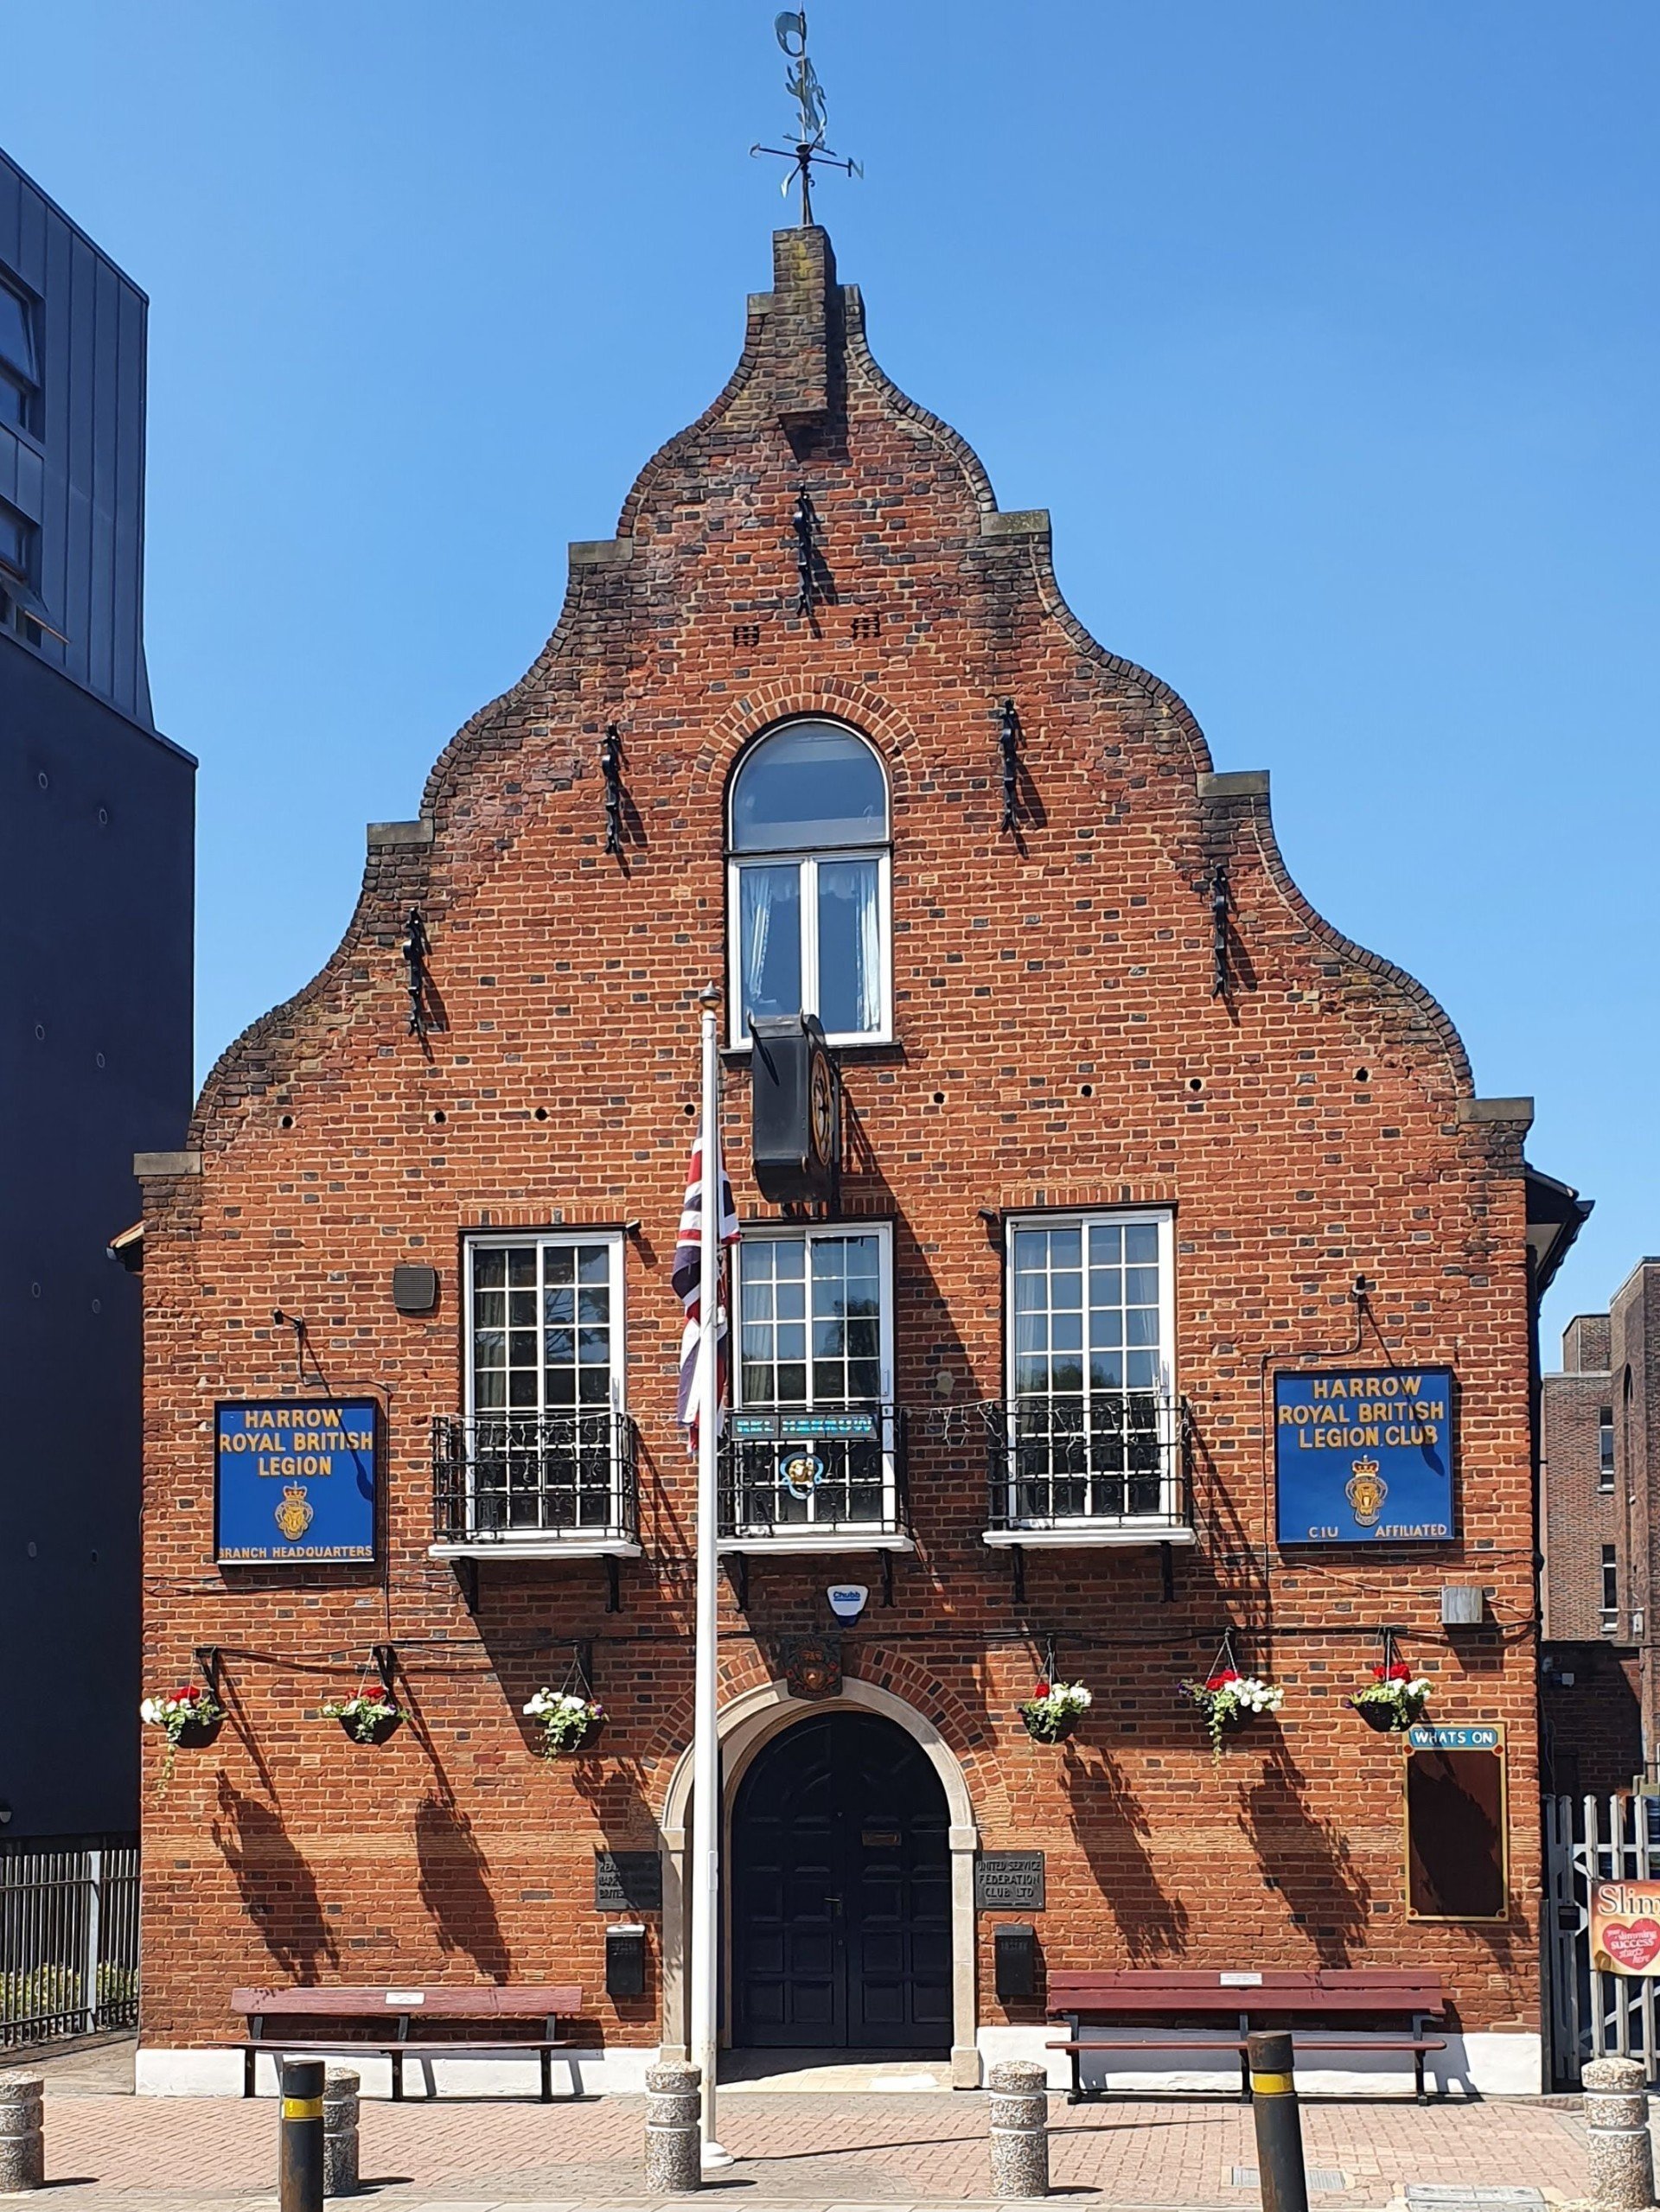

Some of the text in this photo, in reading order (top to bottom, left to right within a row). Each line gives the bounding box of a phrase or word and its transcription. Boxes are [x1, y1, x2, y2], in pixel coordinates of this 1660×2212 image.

[847, 156, 864, 180] N
[1313, 1375, 1421, 1399] HARROW
[245, 1408, 343, 1428] HARROW
[1278, 1400, 1444, 1425] ROYAL BRITISH
[220, 1431, 373, 1452] ROYAL BRITISH
[1385, 1425, 1438, 1446] CLUB
[259, 1456, 332, 1476] LEGION
[1375, 1523, 1447, 1538] AFFILIATED
[219, 1546, 373, 1559] BRANCH HEADQUARTERS
[1414, 1731, 1492, 1744] WHATS ON
[1008, 1861, 1042, 1871] SERVICE
[979, 1874, 1040, 1885] FEDERATION
[986, 1887, 1034, 1897] CLUB LTD
